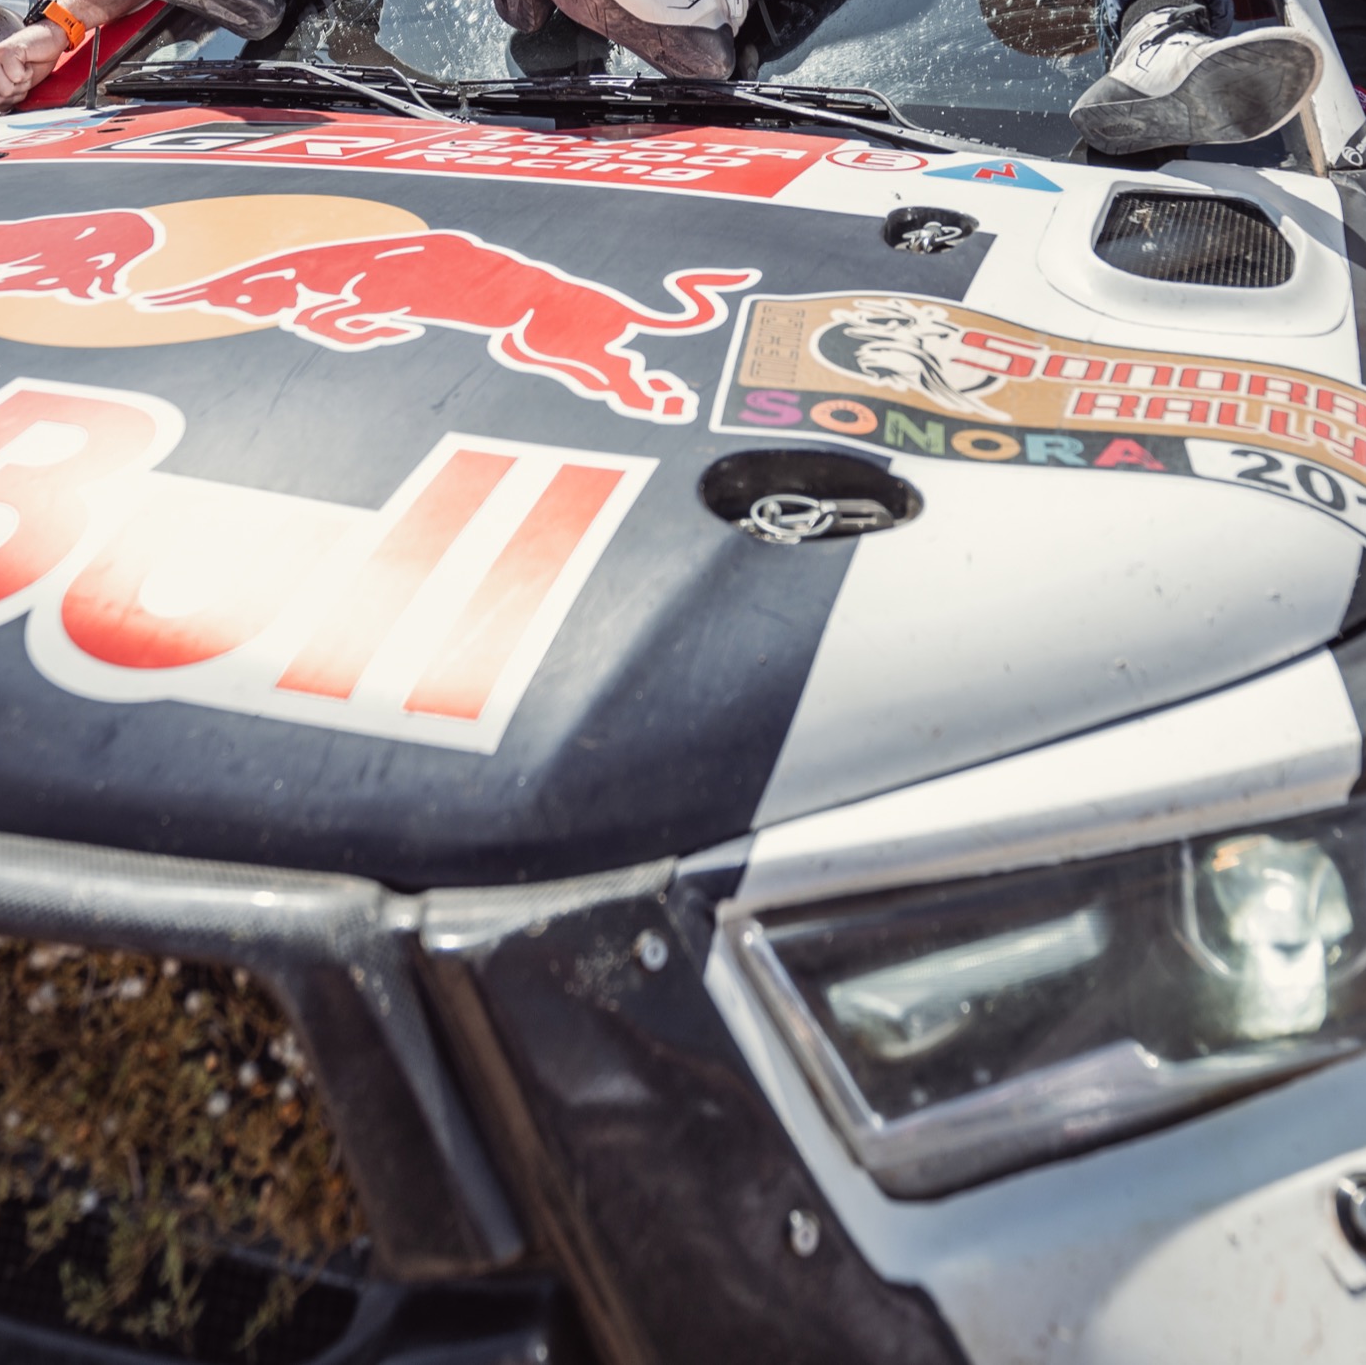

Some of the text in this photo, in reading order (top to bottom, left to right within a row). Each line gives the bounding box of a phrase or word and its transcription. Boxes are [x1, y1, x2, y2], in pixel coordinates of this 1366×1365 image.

[110, 131, 397, 159] GR
[455, 140, 752, 169] GAZOO
[473, 129, 812, 161] TOYOTA
[407, 148, 716, 183] Racing
[738, 389, 1167, 472] SONORA
